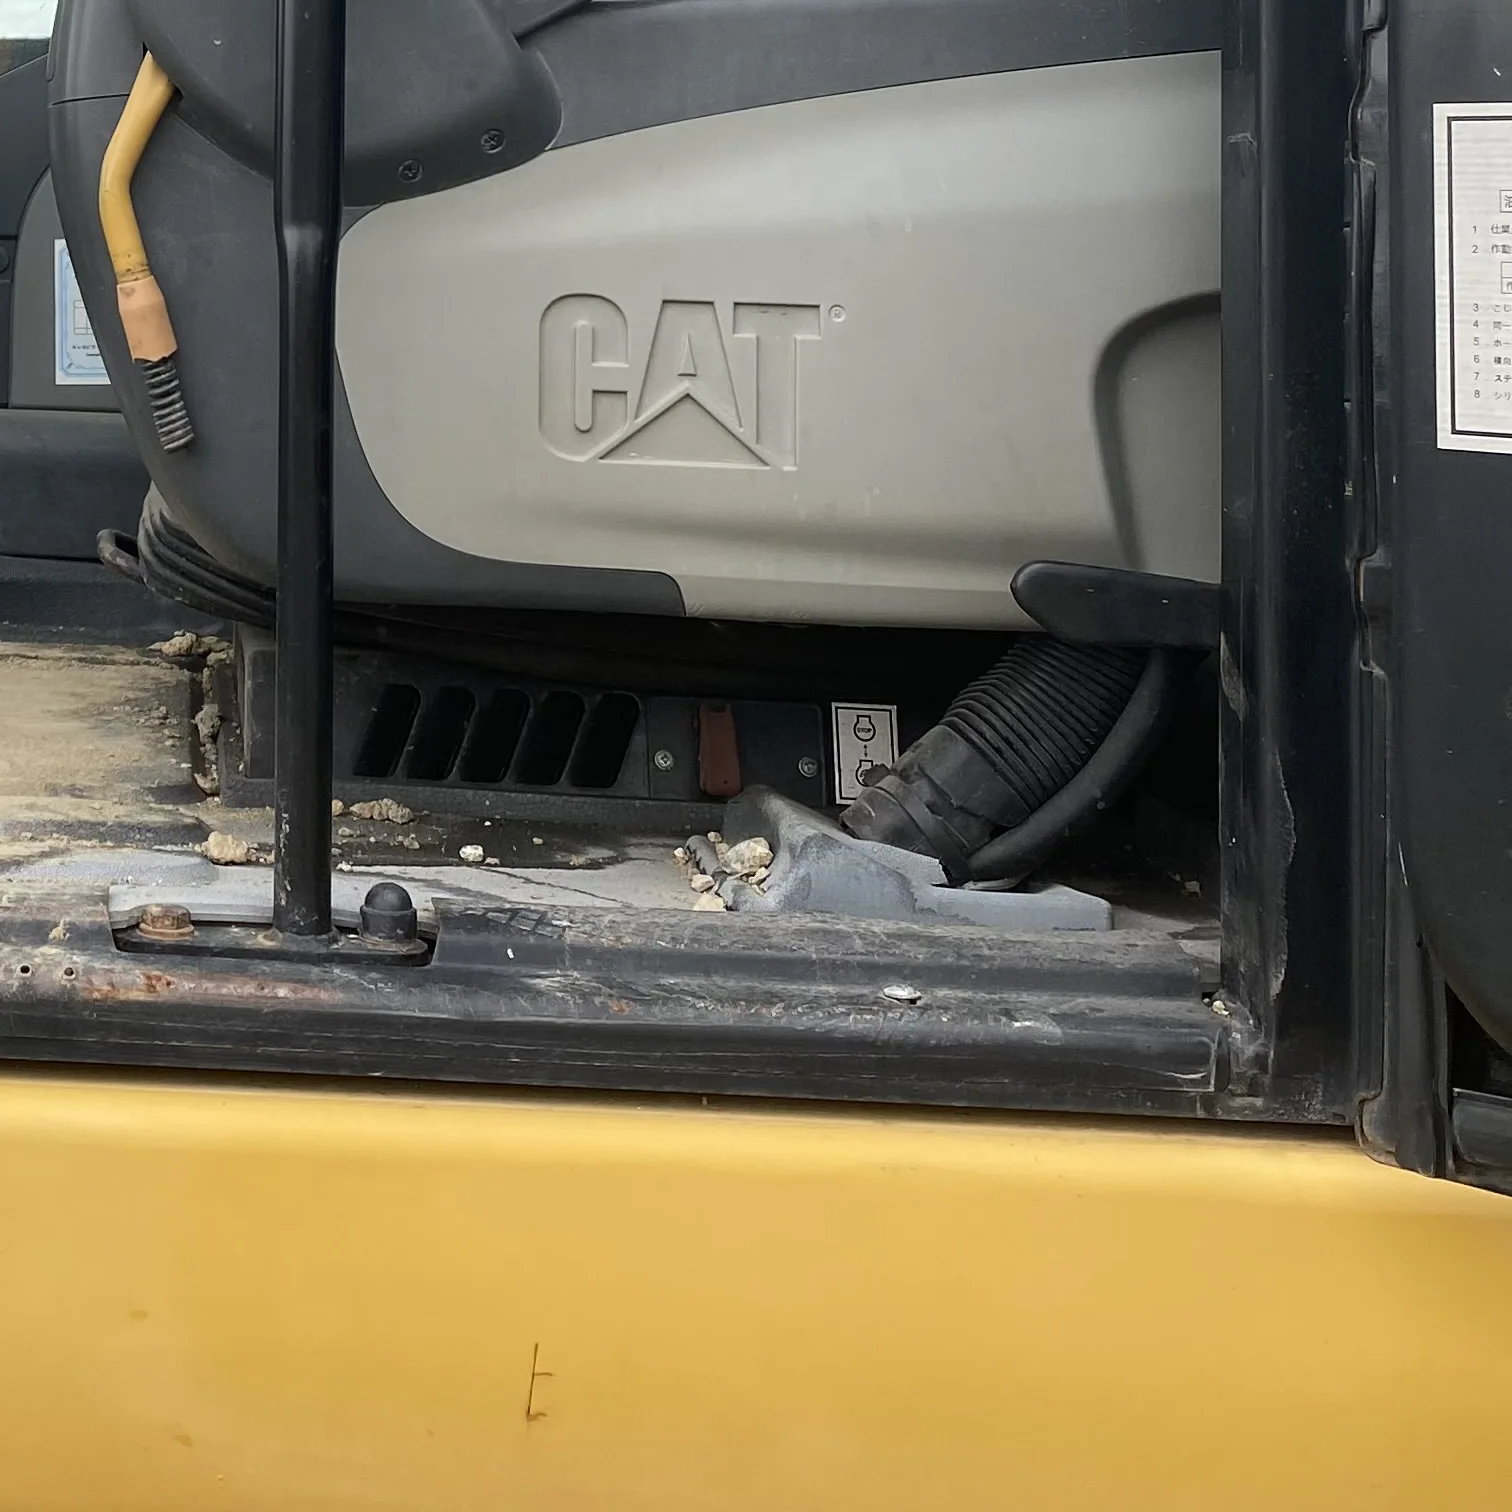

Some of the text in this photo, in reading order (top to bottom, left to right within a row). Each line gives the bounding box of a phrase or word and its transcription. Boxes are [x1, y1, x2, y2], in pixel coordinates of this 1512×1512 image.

[1473, 224, 1512, 234] 1 仕業
[1472, 244, 1512, 254] 2 作動
[1473, 303, 1479, 312] 3
[1473, 320, 1479, 328] 4
[1473, 337, 1479, 346] 5
[1473, 355, 1479, 363] 6
[1474, 372, 1479, 380] 7
[538, 293, 822, 471] CAT
[1474, 390, 1480, 398] 8
